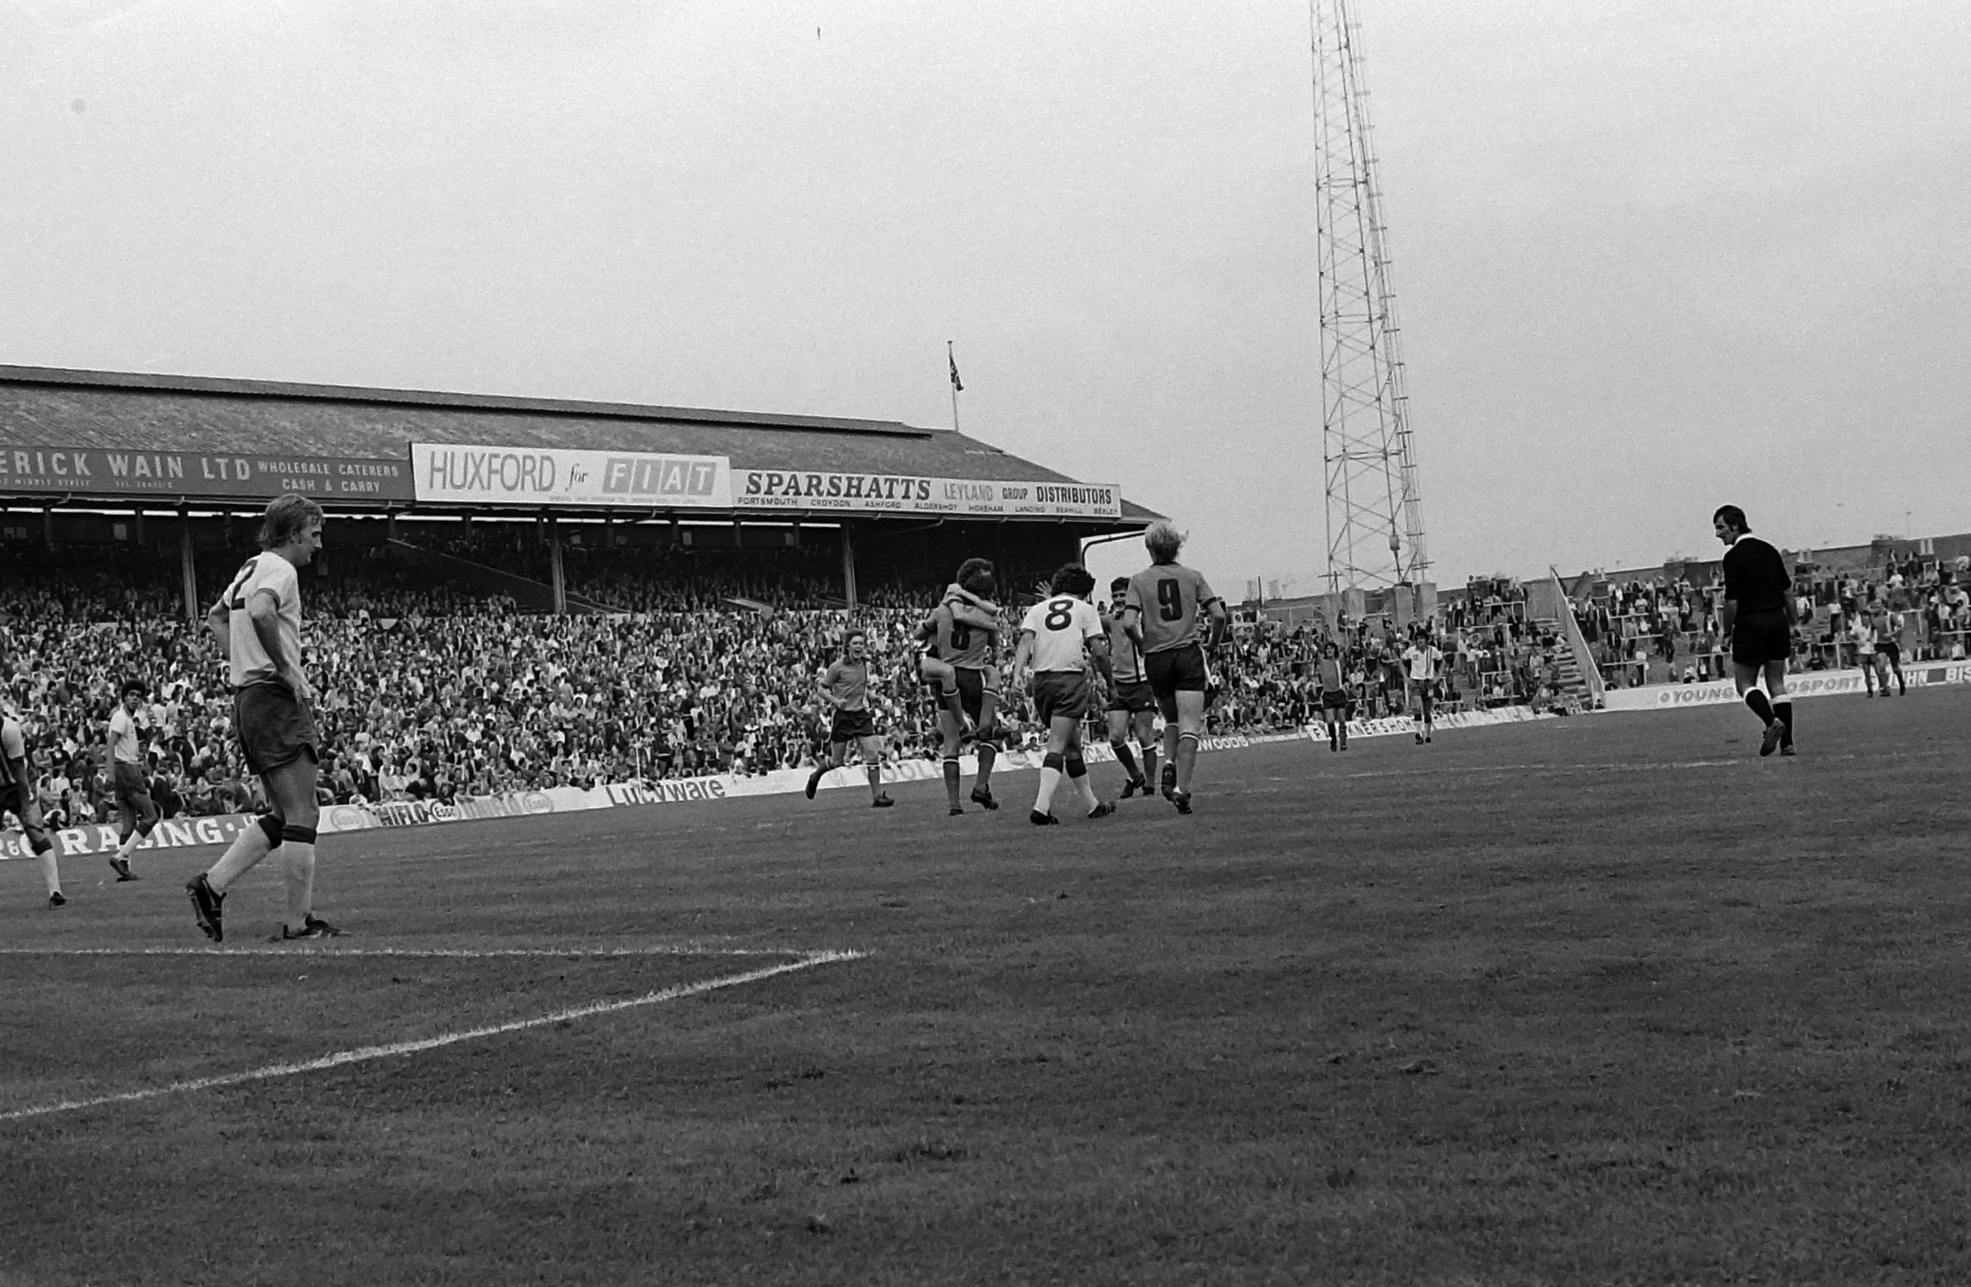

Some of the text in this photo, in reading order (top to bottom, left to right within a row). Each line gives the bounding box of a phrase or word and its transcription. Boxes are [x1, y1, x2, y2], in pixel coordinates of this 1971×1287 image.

[106, 454, 184, 480] WAIN
[201, 457, 251, 480] LTD
[257, 461, 399, 478] WHOLESALE CATERERS
[429, 451, 712, 492] HUXFORD for FIAT
[282, 478, 380, 492] CASH & CARRY
[745, 472, 1113, 504] SPARSHATTS LEYLAND GROUP DISTRIBUTORS
[738, 497, 798, 506] PORTSMOUTH
[810, 498, 851, 508] CROYDON
[864, 501, 901, 509] ASHFORD
[968, 505, 1004, 513] HORSHAM
[1045, 599, 1074, 631] 8
[1157, 578, 1183, 622] 9
[57, 816, 226, 856] RAING
